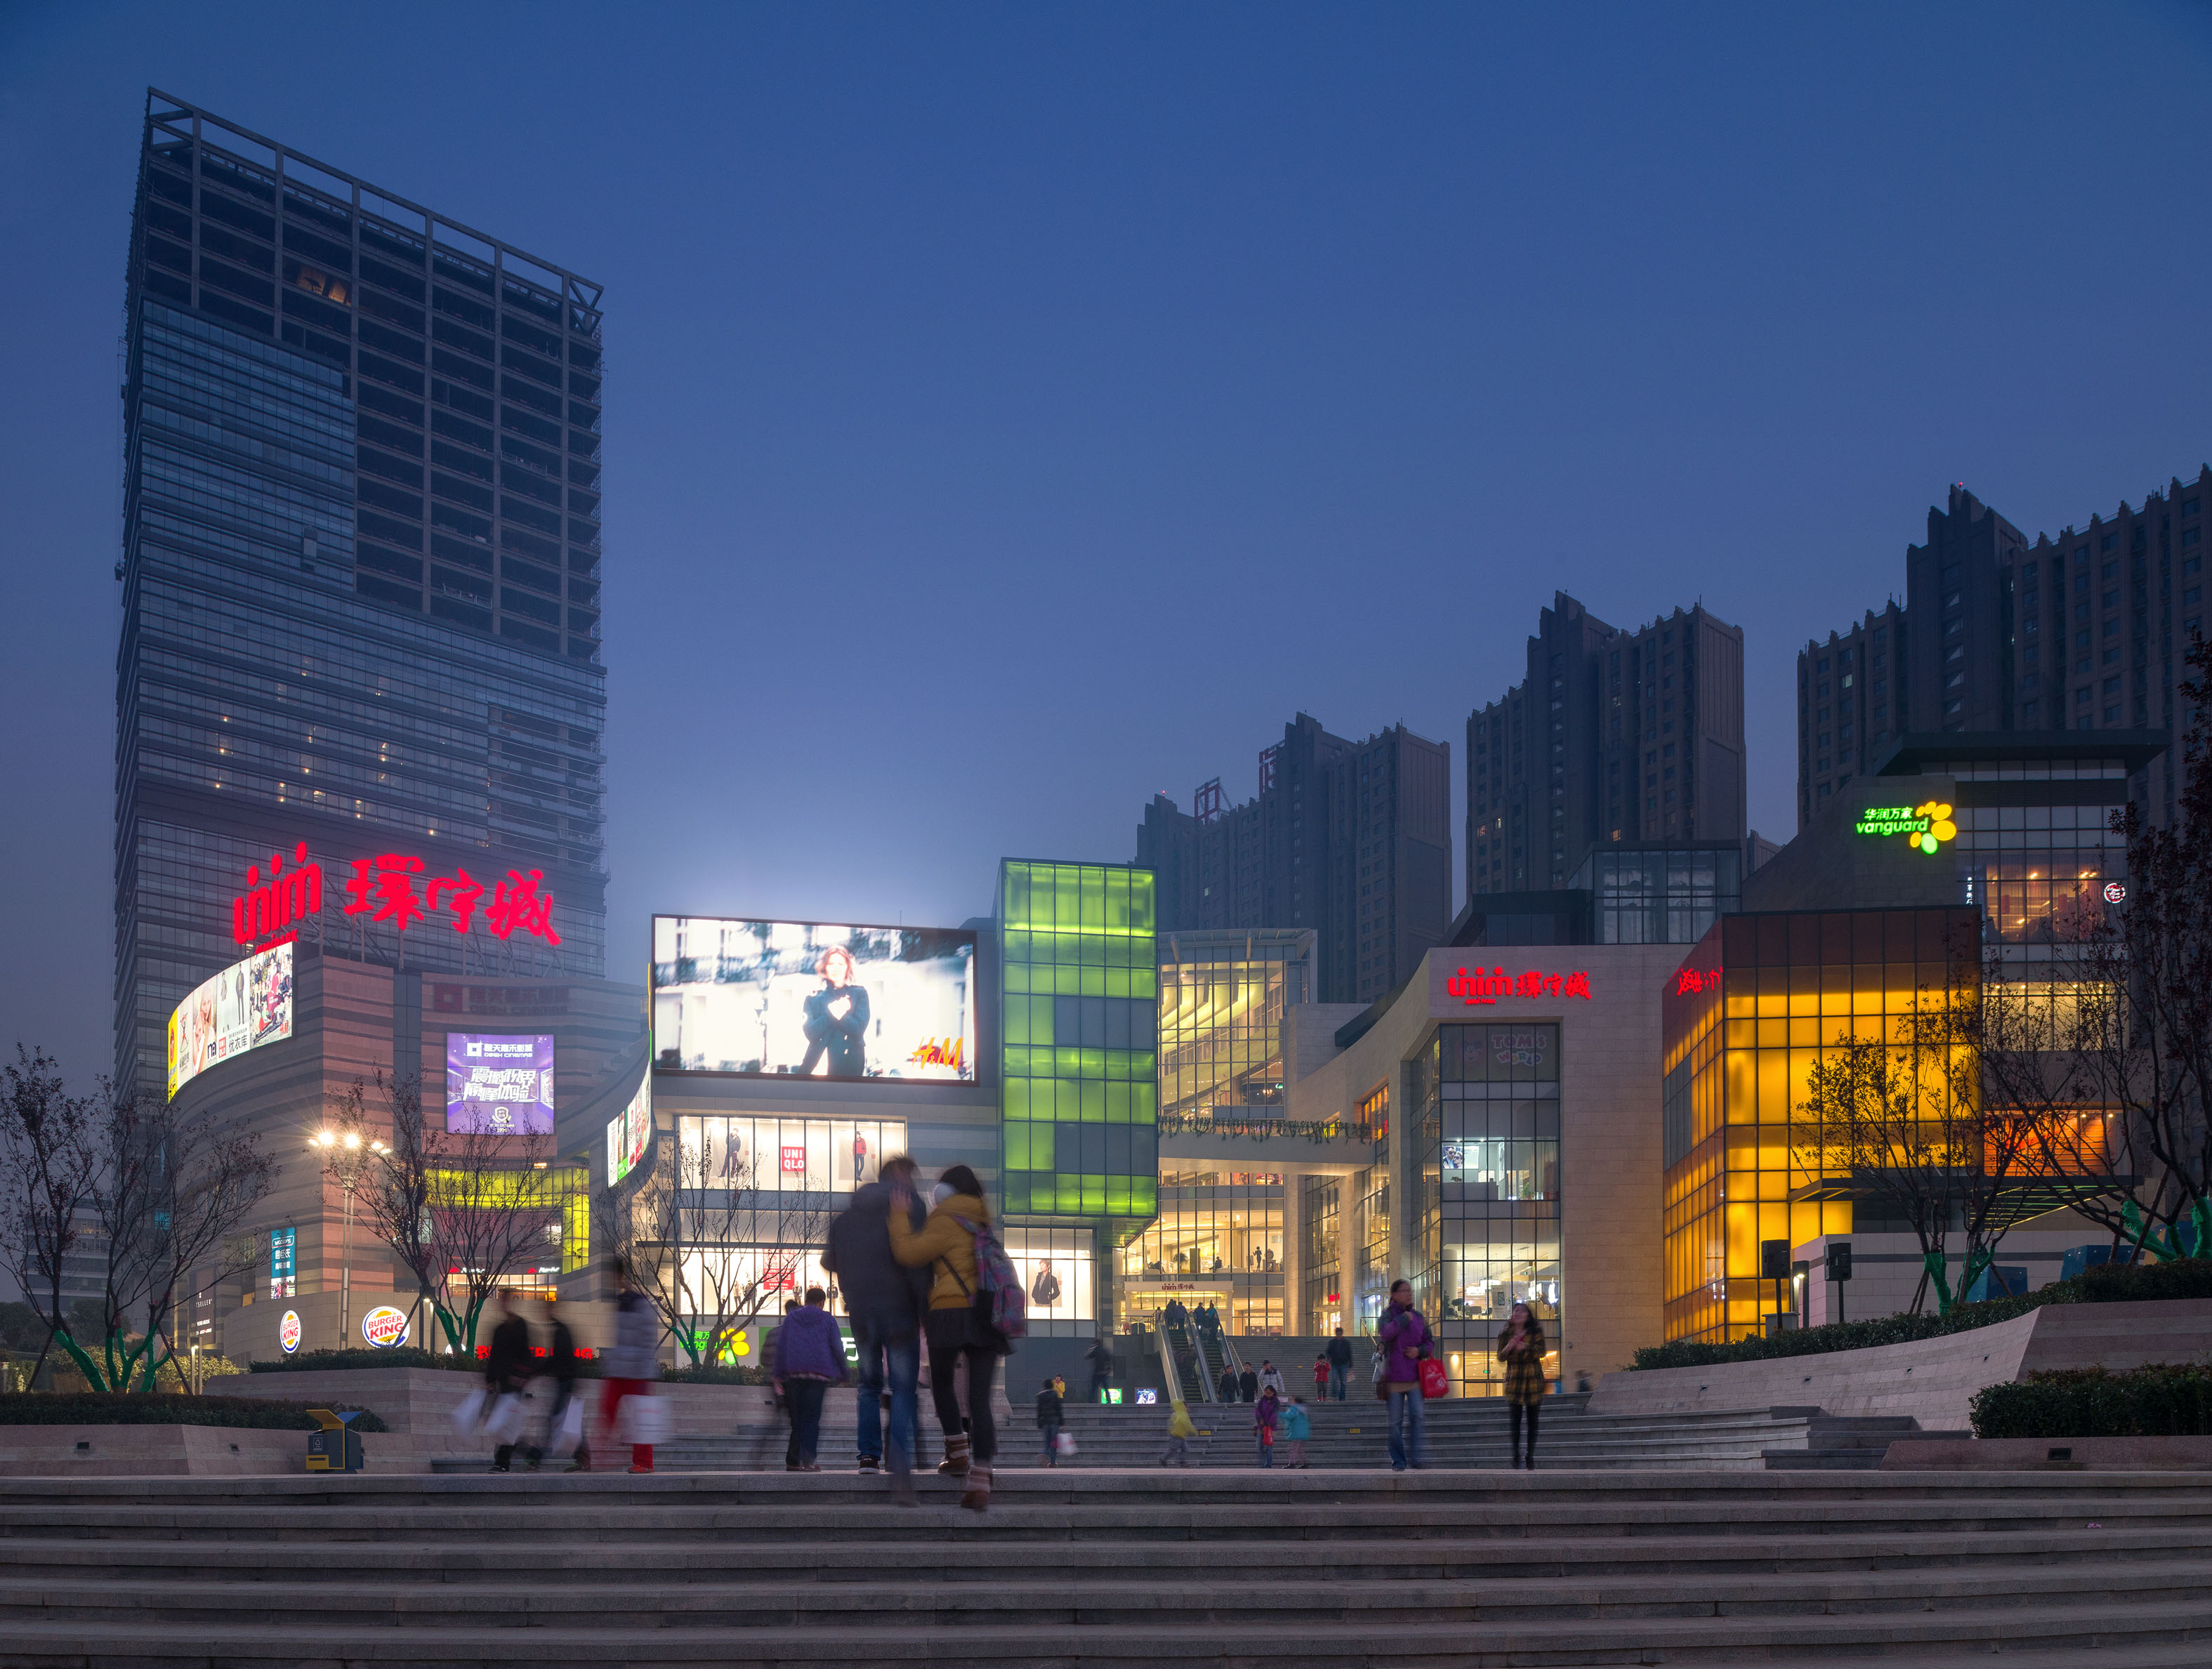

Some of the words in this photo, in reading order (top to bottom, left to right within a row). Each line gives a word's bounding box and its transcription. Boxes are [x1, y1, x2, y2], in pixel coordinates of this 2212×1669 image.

[1864, 807, 1913, 821] 华润万家
[1856, 817, 1929, 836] vanguard
[229, 1034, 247, 1053] 优衣库
[1492, 1034, 1547, 1049] TOM'S
[911, 1036, 963, 1071] H&M
[1496, 1050, 1543, 1067] WORLD
[471, 1067, 536, 1085] 震撼视界
[784, 1149, 803, 1159] UNI
[784, 1159, 805, 1169] QLO
[282, 1319, 298, 1331] BURGER
[368, 1315, 402, 1329] BURGER
[282, 1328, 298, 1341] KING
[369, 1322, 404, 1340] KING
